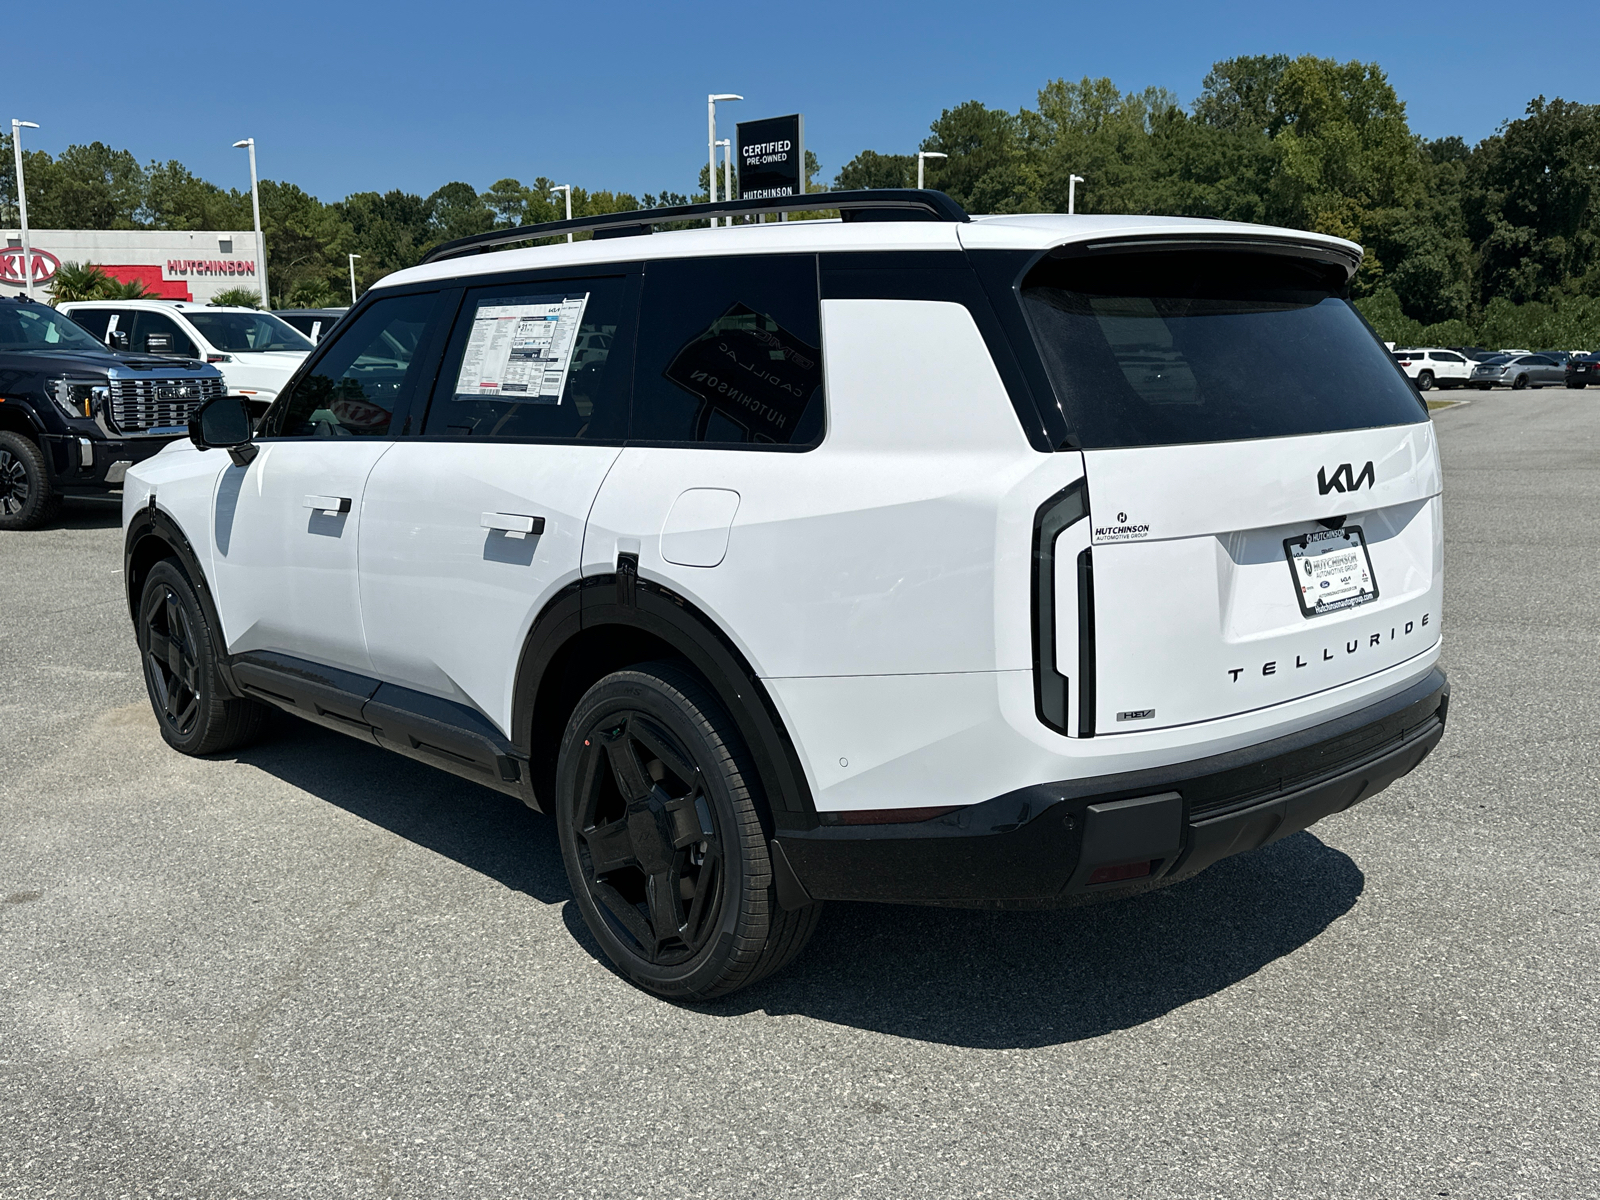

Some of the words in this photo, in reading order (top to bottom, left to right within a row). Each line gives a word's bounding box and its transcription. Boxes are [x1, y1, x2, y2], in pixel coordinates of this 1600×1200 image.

[743, 140, 791, 157] CERTIFIED
[747, 153, 788, 166] PRE-OWNED
[743, 186, 793, 200] HUTCHINSON
[0, 255, 49, 275] KIA
[167, 259, 255, 274] HUTCHINSON
[1316, 460, 1376, 496] KIA
[1095, 524, 1150, 536] HUTCHINSON
[1096, 533, 1130, 541] AUTOMOTIVE
[1312, 528, 1346, 542] HUTCHINSON
[1313, 552, 1358, 572] HUTCHINSON
[1316, 566, 1345, 578] AUTOMOTIVE
[1344, 563, 1358, 573] GROUP
[1228, 613, 1430, 683] TELLURIDE
[1123, 710, 1152, 719] HEV
